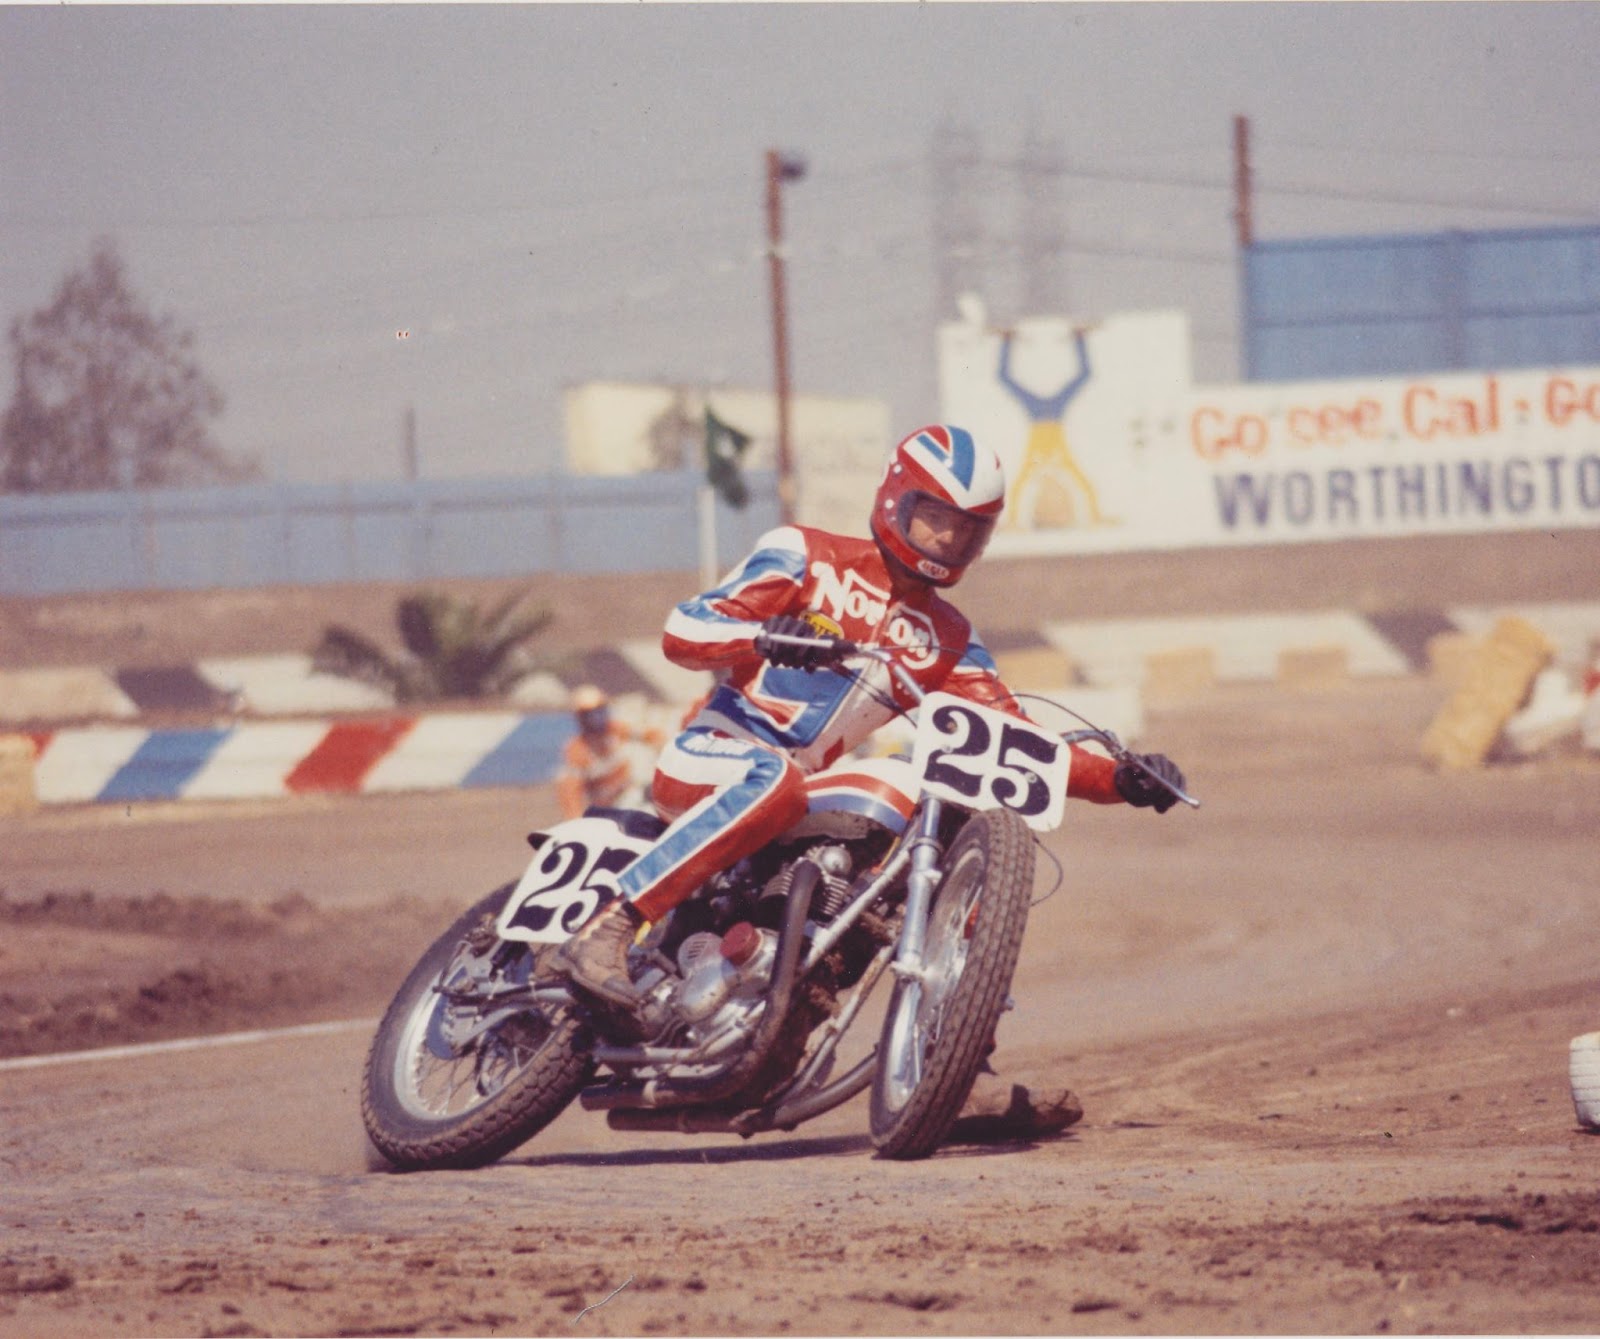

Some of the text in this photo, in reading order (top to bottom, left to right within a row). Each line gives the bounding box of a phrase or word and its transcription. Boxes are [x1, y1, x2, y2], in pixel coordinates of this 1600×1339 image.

[1189, 406, 1269, 460] Go
[1288, 397, 1383, 446] see
[1402, 374, 1501, 441] Cal
[1212, 454, 1600, 531] WORTHINGTO
[923, 705, 1059, 816] 25
[506, 841, 640, 933] 25
